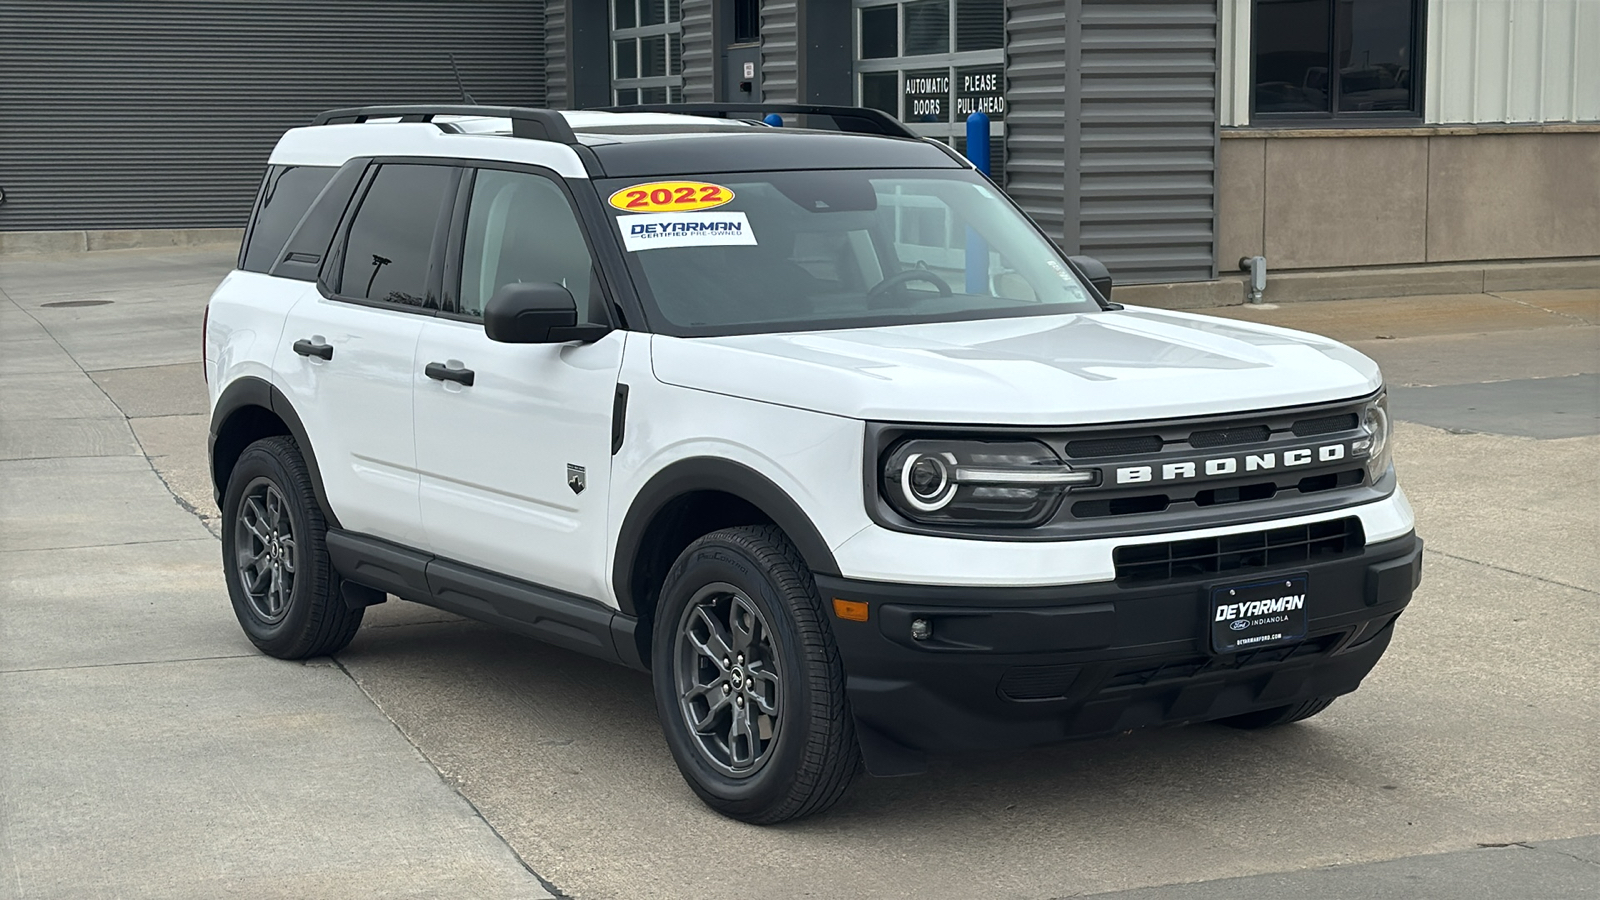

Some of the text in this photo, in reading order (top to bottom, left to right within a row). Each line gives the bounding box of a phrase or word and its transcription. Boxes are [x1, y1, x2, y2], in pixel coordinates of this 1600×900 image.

[906, 77, 949, 94] AUTOMATIC
[965, 74, 997, 92] PLEASE
[914, 99, 940, 115] DOORS
[957, 97, 1004, 114] PULL AHEAD
[626, 186, 722, 208] 2022
[631, 222, 742, 235] DEYARMAN
[641, 231, 688, 239] CERTIFIED
[1116, 444, 1345, 484] BRONCO
[1215, 594, 1305, 621] DEYARMAN
[1251, 615, 1289, 626] INDIANOLA
